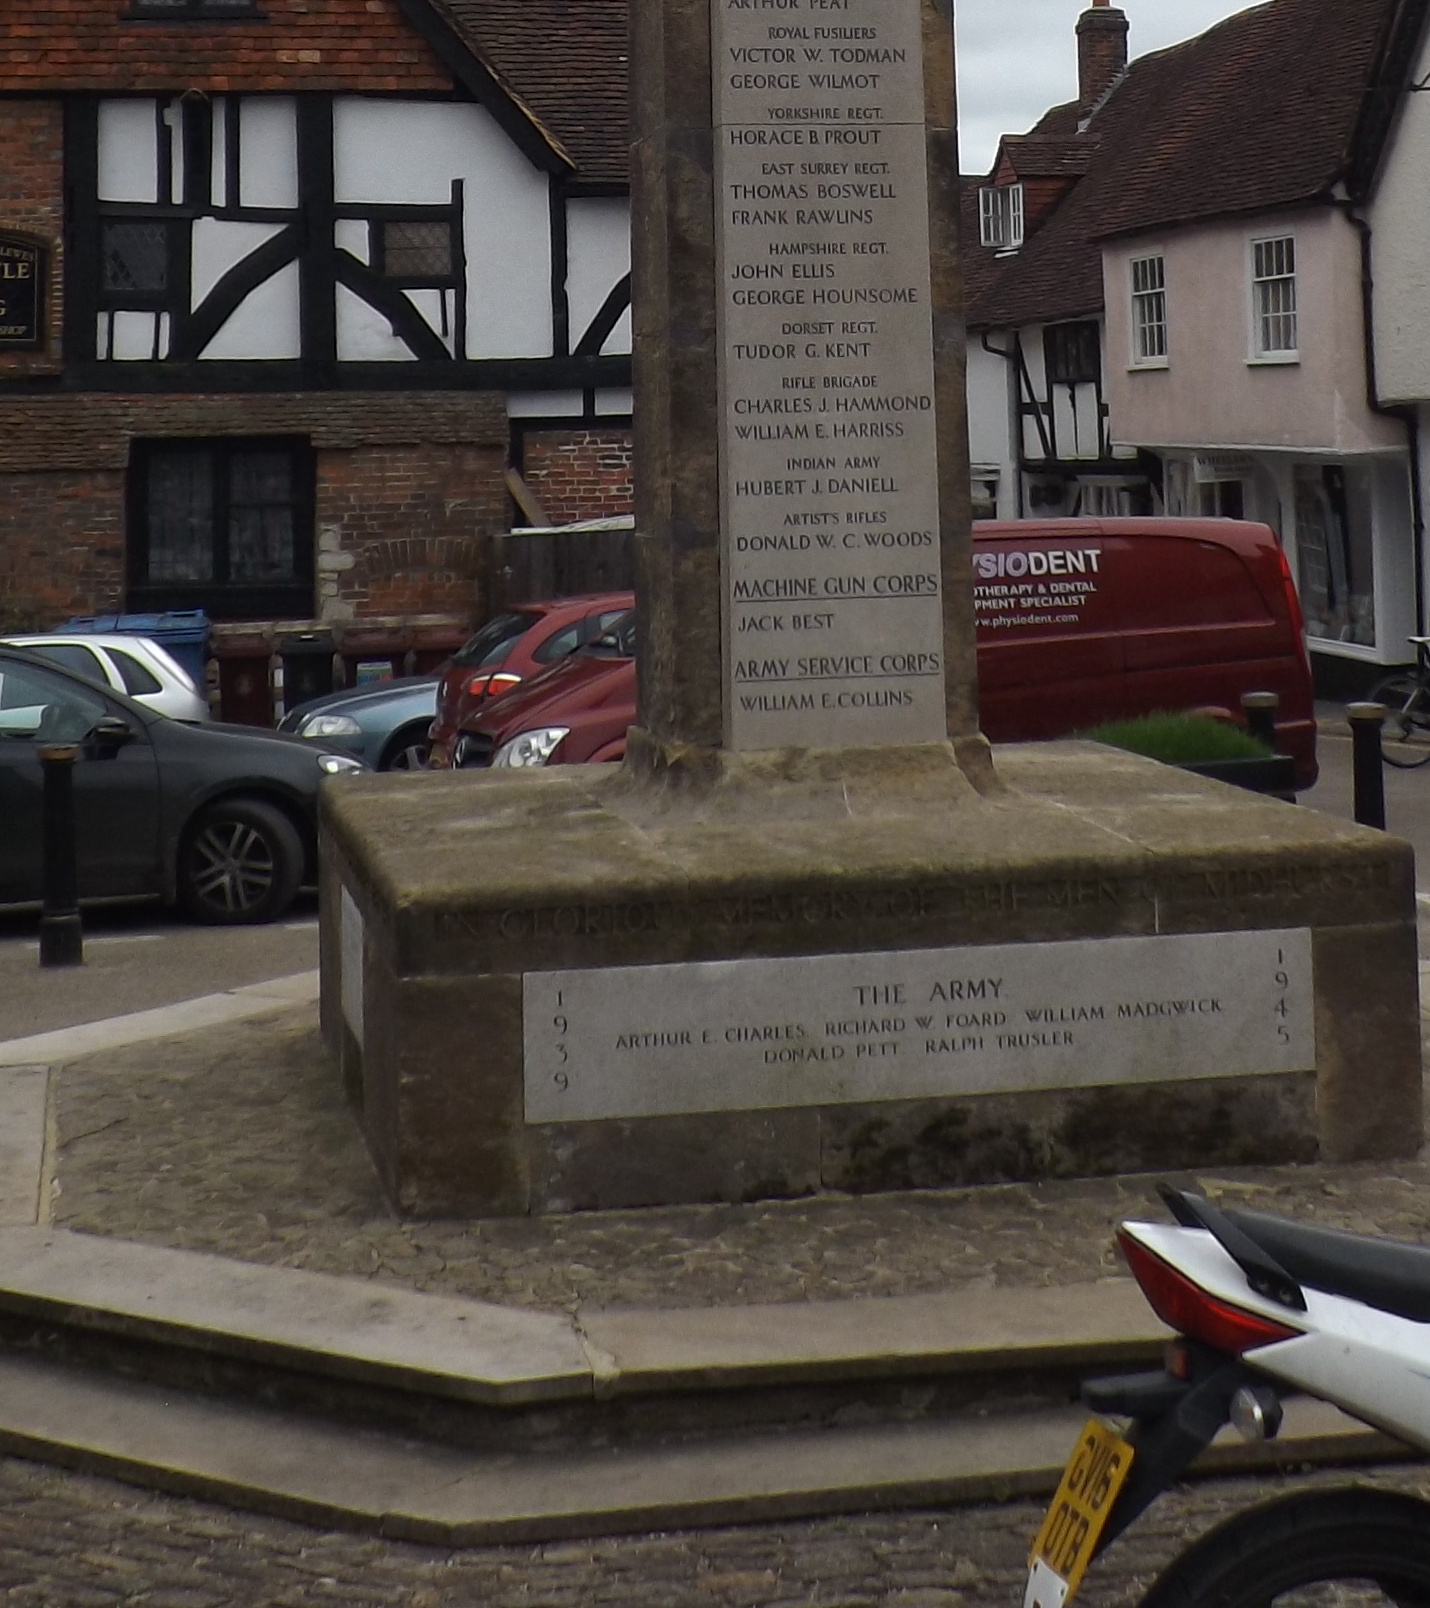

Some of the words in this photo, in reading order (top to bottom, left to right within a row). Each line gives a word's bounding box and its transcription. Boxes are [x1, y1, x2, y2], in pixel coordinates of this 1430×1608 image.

[768, 27, 810, 40] ROYAL
[814, 27, 877, 40] FUSILIERS
[729, 47, 796, 63] VICTOR
[803, 48, 823, 63] W.
[829, 48, 906, 63] TODMAN
[730, 74, 801, 89] GEORGE
[808, 75, 881, 89] WILMOT
[768, 108, 841, 120] YORKSHIRE
[847, 108, 884, 120] REGT.
[730, 130, 804, 145] HORACE
[825, 130, 882, 144] PROUT
[762, 163, 794, 175] EAST
[800, 163, 849, 174] SURREY
[854, 163, 891, 174] REGT.
[730, 185, 809, 199] THOMAS
[817, 184, 897, 198] BOSWELL
[732, 210, 789, 225] FRANK
[796, 210, 874, 225] RAWLINS
[0, 246, 34, 261] LEWES
[770, 243, 847, 255] HAMPSHIRE
[852, 243, 889, 255] REGT.
[731, 264, 784, 279] JOHN
[792, 264, 835, 279] ELLIS
[732, 290, 805, 305] GEORGE
[813, 288, 918, 304] HOUNSOME
[782, 322, 835, 335] DORSET
[842, 322, 878, 334] REGT.
[733, 344, 796, 359] TUDOR
[805, 344, 821, 358] G.
[826, 343, 871, 358] KENT
[782, 377, 816, 389] RIFLE
[823, 375, 878, 388] BRIGADE
[734, 398, 812, 414] CHARLES
[836, 396, 931, 412] HAMMOND
[735, 424, 809, 440] WILLIAM
[815, 424, 829, 439] E.
[833, 422, 904, 438] HARRISS
[787, 457, 836, 470] INDIAN
[844, 456, 881, 469] ARMY
[735, 480, 807, 496] HUBERT
[828, 478, 899, 493] DANIELL
[846, 511, 887, 524] RIFLES
[737, 535, 811, 552] DONALD
[816, 534, 836, 549] W.
[842, 533, 861, 549] C.
[864, 531, 933, 548] WOODS
[733, 578, 817, 598] MACHINE
[824, 576, 866, 594] GUN
[873, 574, 938, 593] CORPS
[1038, 583, 1047, 594] &
[1051, 581, 1097, 594] DENTAL
[1020, 595, 1086, 608] SPECIALIST
[738, 616, 783, 632] JACK
[792, 614, 835, 630] BEST
[734, 659, 790, 679] ARMY
[797, 655, 873, 676] SERVICE
[880, 653, 940, 673] CORPS
[740, 694, 815, 712] WILLIAM
[838, 691, 913, 708] COLLINS
[853, 983, 907, 1007] THE
[615, 1030, 692, 1050] ARTHUR
[825, 1017, 906, 1037] RICHARD
[1024, 1005, 1106, 1024] WILLIAM
[764, 1044, 845, 1065] DONALD
[925, 1033, 984, 1054] RALPH
[997, 1031, 1073, 1051] TRUSLER
